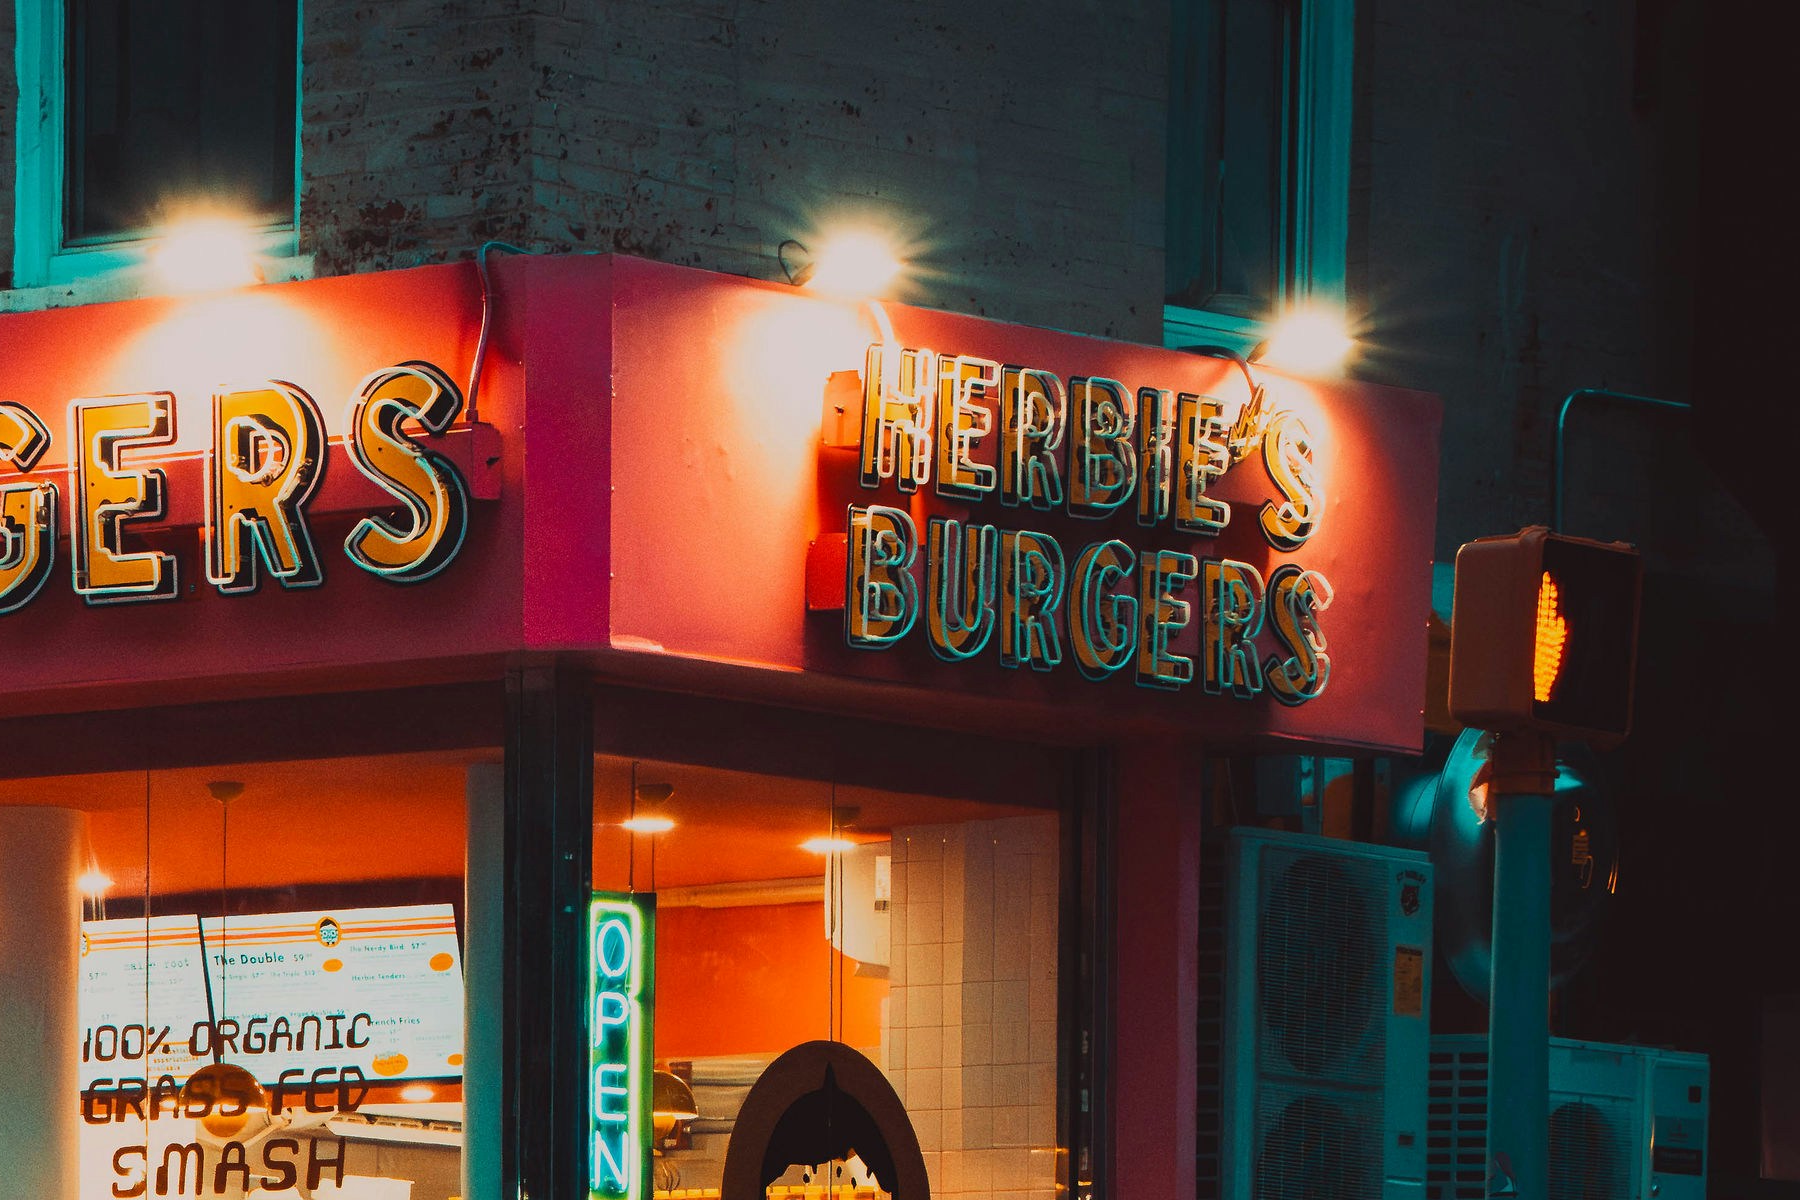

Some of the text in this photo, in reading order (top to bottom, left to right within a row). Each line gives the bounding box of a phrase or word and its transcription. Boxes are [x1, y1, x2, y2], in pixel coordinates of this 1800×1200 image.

[859, 342, 1326, 552] HERBIE'S
[845, 502, 1335, 707] BURGERS
[213, 954, 236, 967] The
[240, 951, 285, 965] Double
[82, 1023, 171, 1063] 100%
[187, 1012, 372, 1058] ORGANIC
[371, 1016, 421, 1026] rench Fries
[593, 917, 634, 1193] OPEN
[82, 1064, 370, 1126] GRASS FED
[111, 1135, 346, 1199] SMASH
